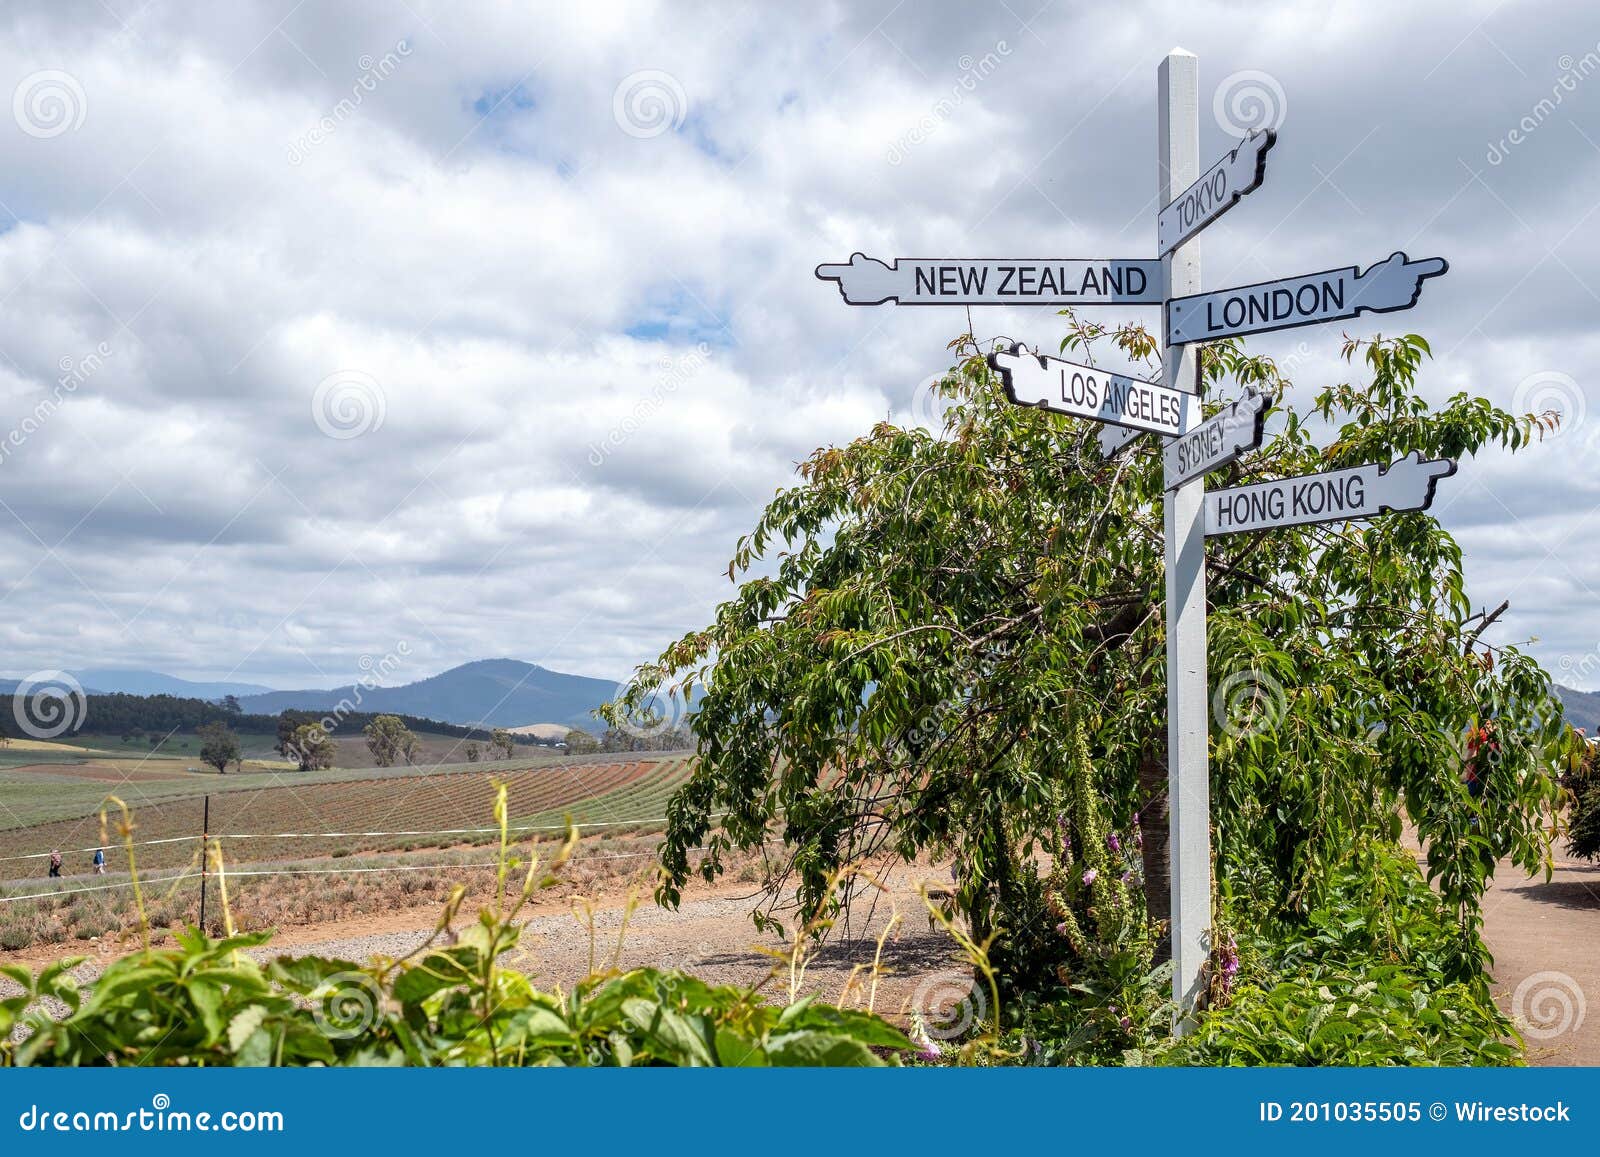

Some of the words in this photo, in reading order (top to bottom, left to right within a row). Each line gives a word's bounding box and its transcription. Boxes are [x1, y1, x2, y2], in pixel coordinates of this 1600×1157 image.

[1176, 168, 1227, 233] TOKYO
[915, 266, 988, 296] NEW
[997, 266, 1147, 296] ZEALAND
[1207, 278, 1344, 332] LONDON
[1061, 370, 1098, 409] LOS
[1102, 380, 1181, 428] ANGELES
[1177, 417, 1226, 475] SYDNEY
[1218, 487, 1285, 527] HONG
[1292, 475, 1365, 517] KONG
